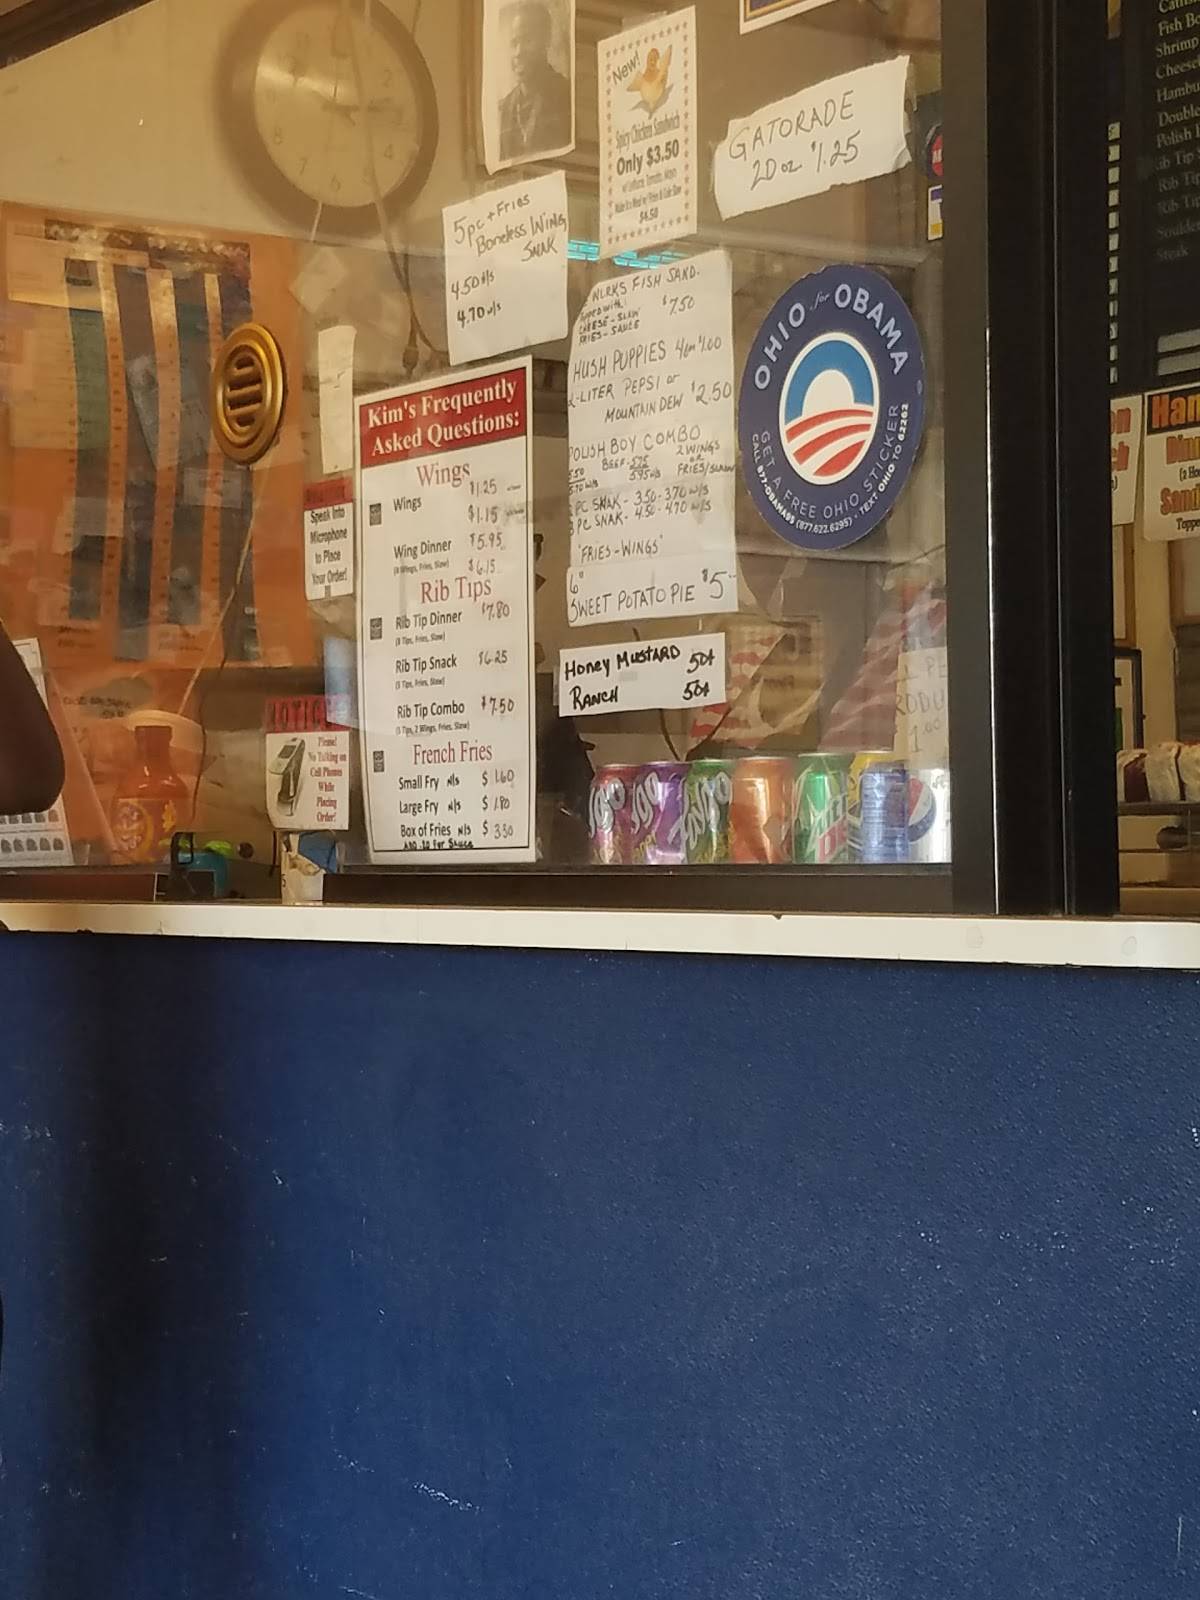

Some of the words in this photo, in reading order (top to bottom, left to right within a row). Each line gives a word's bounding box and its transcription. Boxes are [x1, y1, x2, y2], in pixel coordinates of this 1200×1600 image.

[1158, 17, 1183, 36] Fish
[1156, 37, 1199, 58] Shrimp
[612, 50, 640, 85] New!
[728, 89, 855, 161] GATORADE
[616, 153, 643, 175] Only
[646, 138, 680, 168] $3.50
[632, 273, 662, 291] FISH
[754, 302, 806, 390] OHIO
[812, 291, 830, 310] for
[834, 283, 909, 375] OBAMA
[573, 355, 607, 383] HUSH
[612, 340, 666, 374] PUPPIES
[624, 376, 661, 397] PEPSI
[368, 401, 416, 429] Kim's
[421, 378, 517, 417] Frequently
[604, 399, 656, 424] MOUNTAIN
[659, 394, 684, 412] DEW
[372, 428, 423, 457] Asked
[427, 410, 520, 447] Questions:
[610, 435, 636, 455] BOY
[643, 424, 701, 451] COMBO
[686, 440, 720, 455] WINGS
[752, 433, 761, 464] CALL
[859, 492, 878, 515] TEXT
[878, 463, 895, 492] OHIO
[891, 444, 902, 460] TO
[761, 431, 776, 467] GET
[773, 476, 782, 489] A
[783, 489, 817, 519] FREE
[823, 493, 860, 519] OHIO
[863, 405, 899, 492] STICKER
[416, 462, 471, 488] Wings
[393, 496, 422, 512] Wings
[310, 509, 330, 524] Speak
[310, 528, 348, 545] Microphone
[323, 549, 341, 563] Place
[393, 544, 418, 560] Wing
[420, 539, 452, 555] Dinner
[420, 579, 450, 604] Rib
[454, 575, 492, 602] Tips
[569, 592, 613, 623] SWEET
[618, 586, 666, 611] POTATO
[670, 583, 696, 604] PIE
[395, 616, 411, 630] Rib
[412, 613, 428, 630] Tip
[429, 610, 463, 626] Dinner
[395, 660, 411, 674] Rib
[413, 657, 427, 674] Tip
[429, 653, 458, 669] Snack
[565, 657, 610, 681] Honey
[397, 704, 412, 719] Rib
[414, 703, 428, 720] Tip
[430, 699, 465, 716] Combo
[569, 685, 619, 711] RANCH
[413, 741, 456, 766] French
[459, 739, 493, 763] Fries
[398, 774, 423, 791] Small
[424, 775, 440, 792] Fry
[399, 799, 423, 816] Large
[424, 799, 439, 816] Fry
[400, 824, 416, 838] Box
[417, 822, 428, 837] of
[429, 823, 451, 837] Fries
